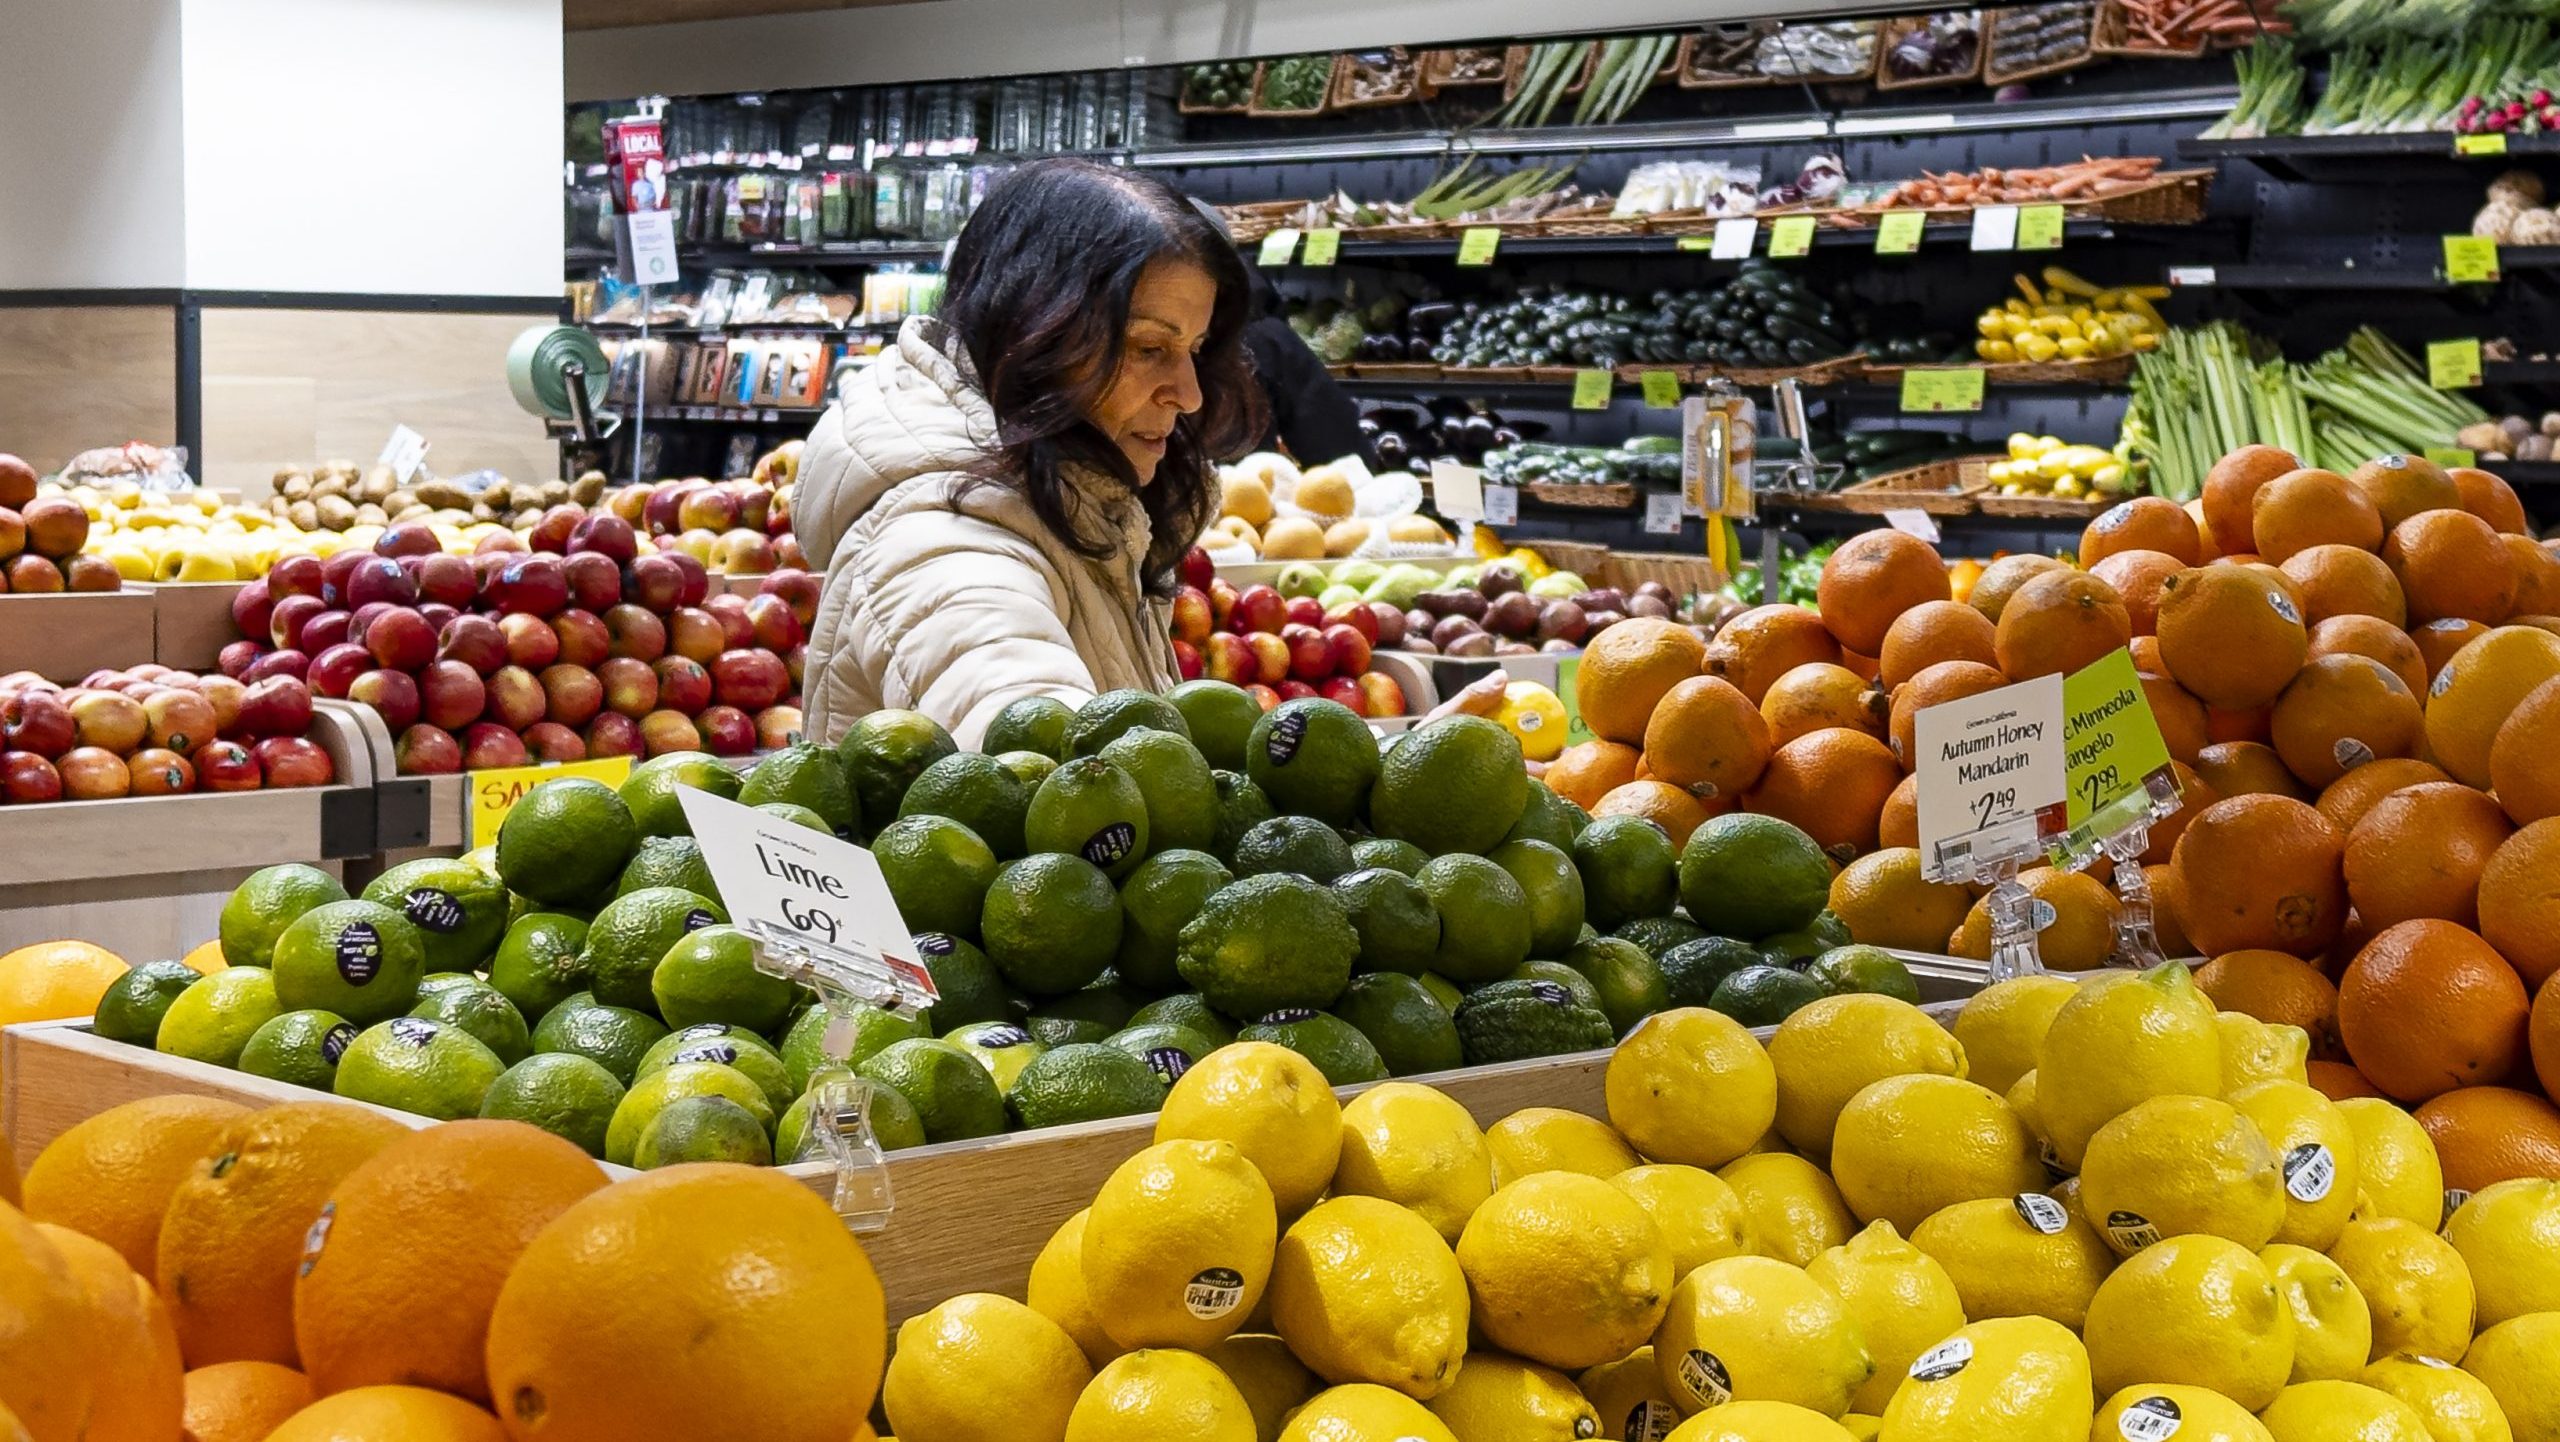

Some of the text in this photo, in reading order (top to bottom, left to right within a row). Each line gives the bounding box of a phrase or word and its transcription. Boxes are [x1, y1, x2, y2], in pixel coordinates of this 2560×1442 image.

[624, 134, 661, 153] LOCAL
[2070, 689, 2137, 735] Minneola
[1941, 735, 1995, 761] Autumn
[1997, 721, 2043, 747] Honey
[2064, 733, 2114, 773] angelo
[1958, 751, 2029, 785] Mandarin
[754, 843, 849, 899] Lime
